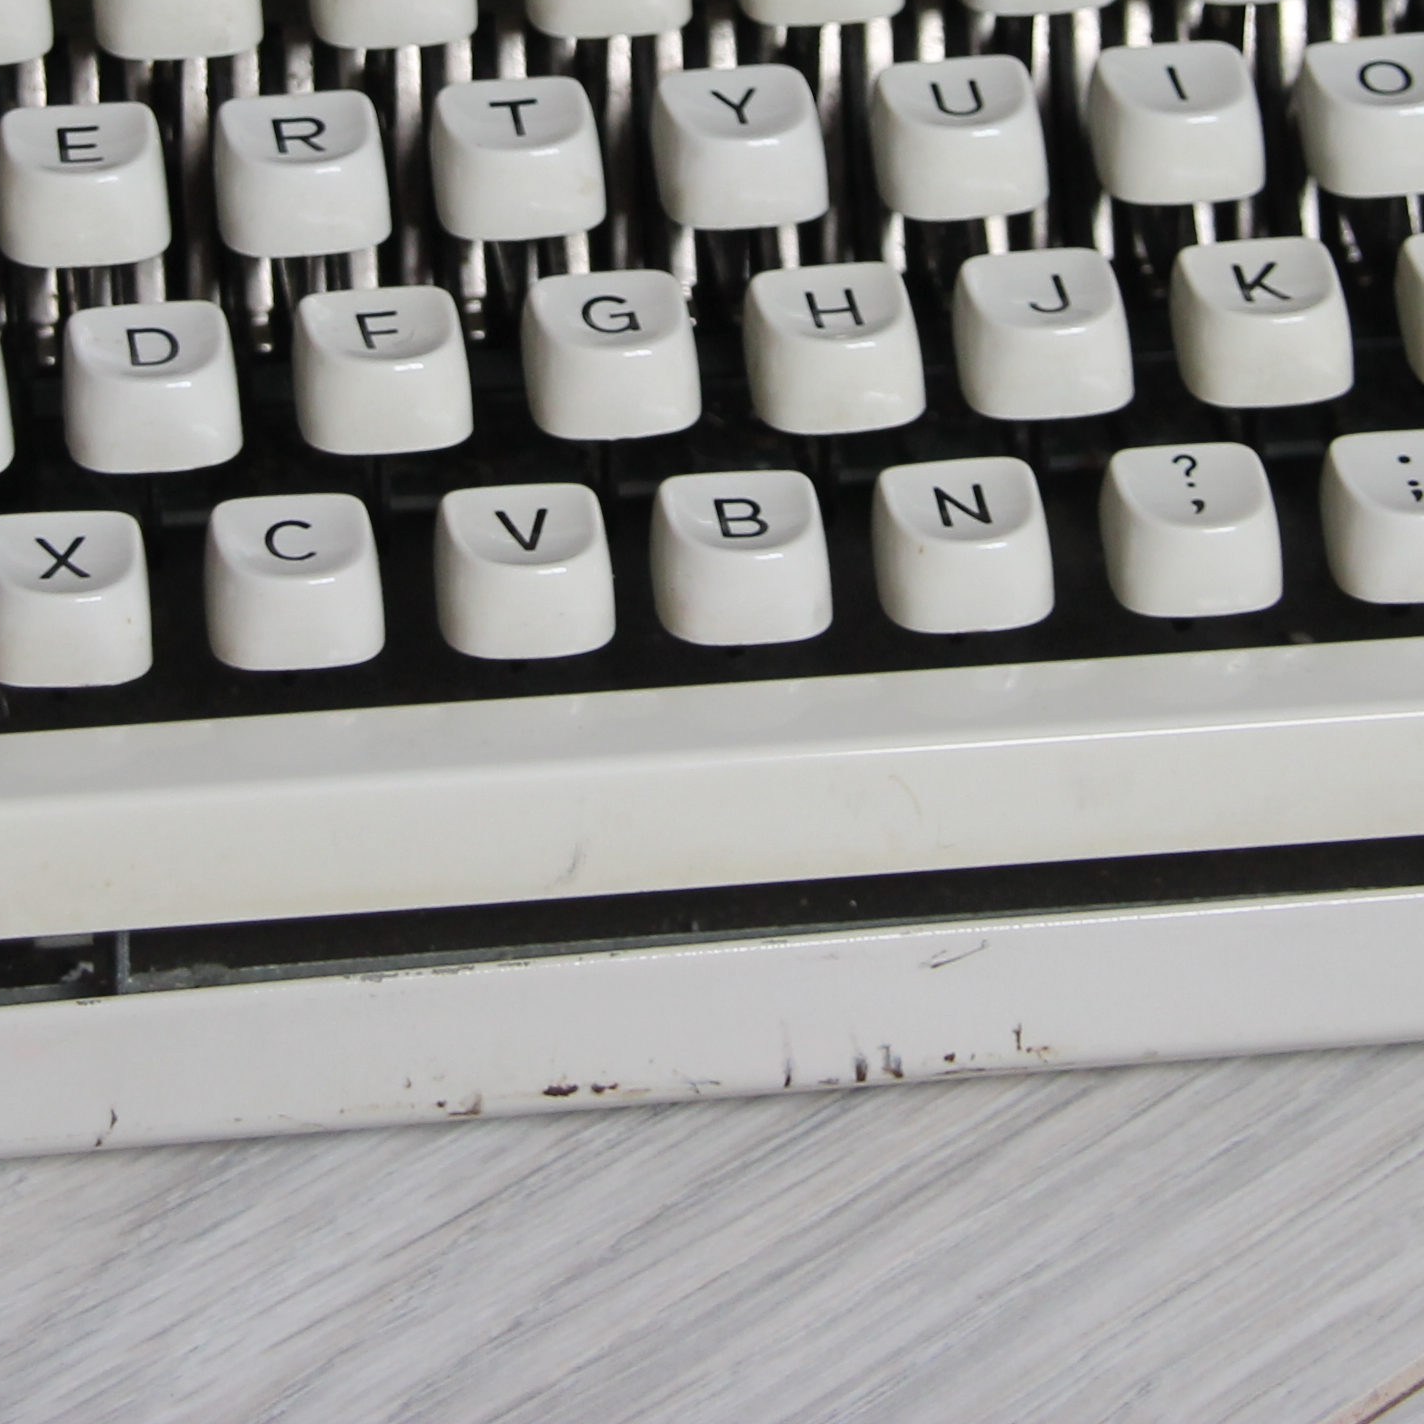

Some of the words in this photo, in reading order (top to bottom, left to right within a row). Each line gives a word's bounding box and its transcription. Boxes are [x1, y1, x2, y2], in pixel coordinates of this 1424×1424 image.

[1167, 66, 1188, 101] I
[1359, 60, 1413, 95] O
[711, 87, 756, 125] Y
[931, 79, 985, 116] U
[271, 116, 326, 154] R
[488, 98, 538, 137] T
[56, 125, 104, 163] E
[1029, 274, 1070, 313] J
[1232, 261, 1292, 303] K
[581, 295, 642, 334] G
[805, 287, 865, 330] H
[125, 326, 180, 367] D
[355, 310, 399, 350] F
[1171, 454, 1198, 488] ?
[714, 496, 770, 539] B
[933, 483, 993, 528] N
[264, 519, 317, 562] C
[495, 507, 549, 552] V
[34, 536, 91, 579] X
